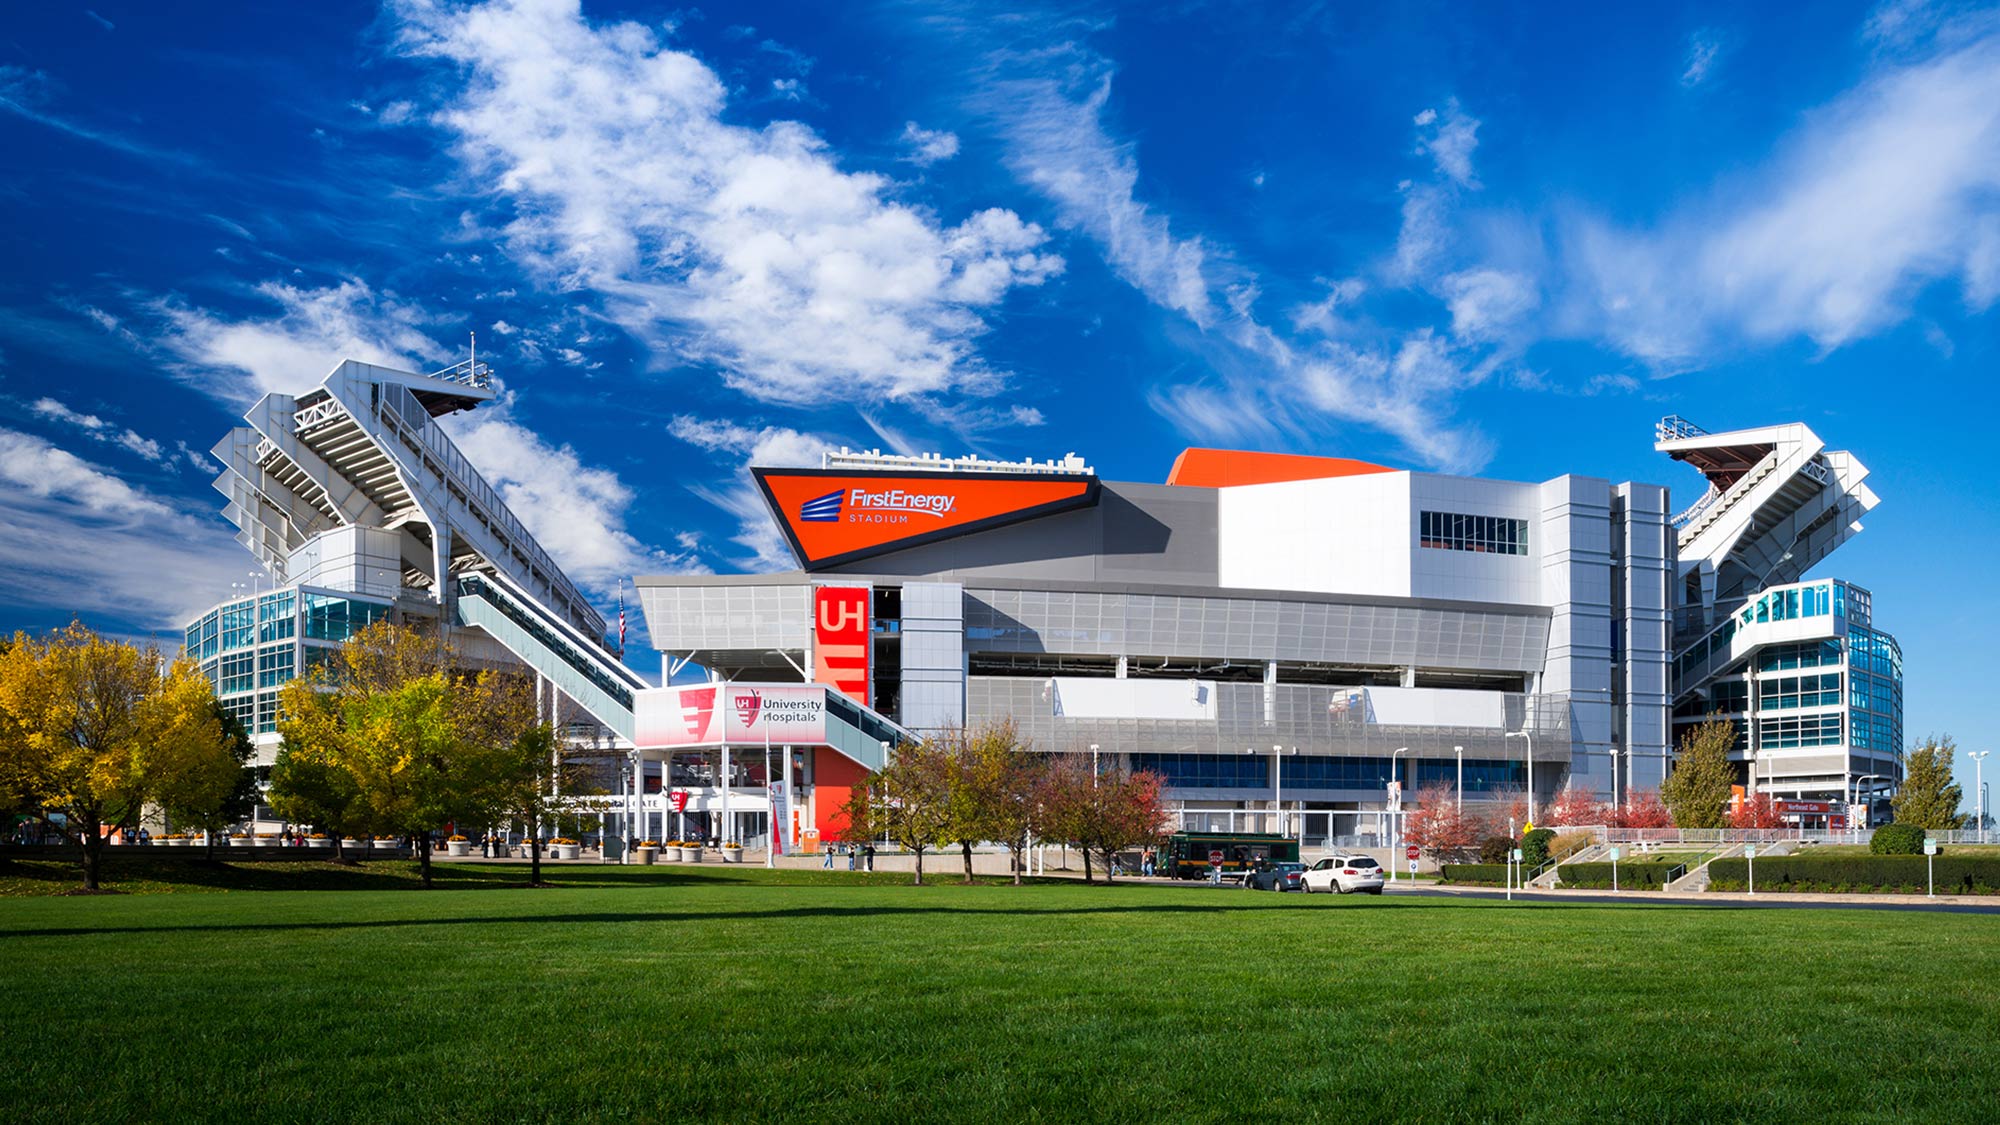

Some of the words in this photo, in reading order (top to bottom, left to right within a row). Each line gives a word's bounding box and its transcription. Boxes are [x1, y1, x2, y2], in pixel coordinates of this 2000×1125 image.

[850, 489, 955, 512] FirstEnergy
[849, 514, 908, 523] STADIUM
[821, 600, 864, 632] UH
[736, 699, 749, 708] UH
[763, 699, 822, 712] University
[763, 711, 817, 723] Hospitals
[1209, 854, 1224, 863] STOP
